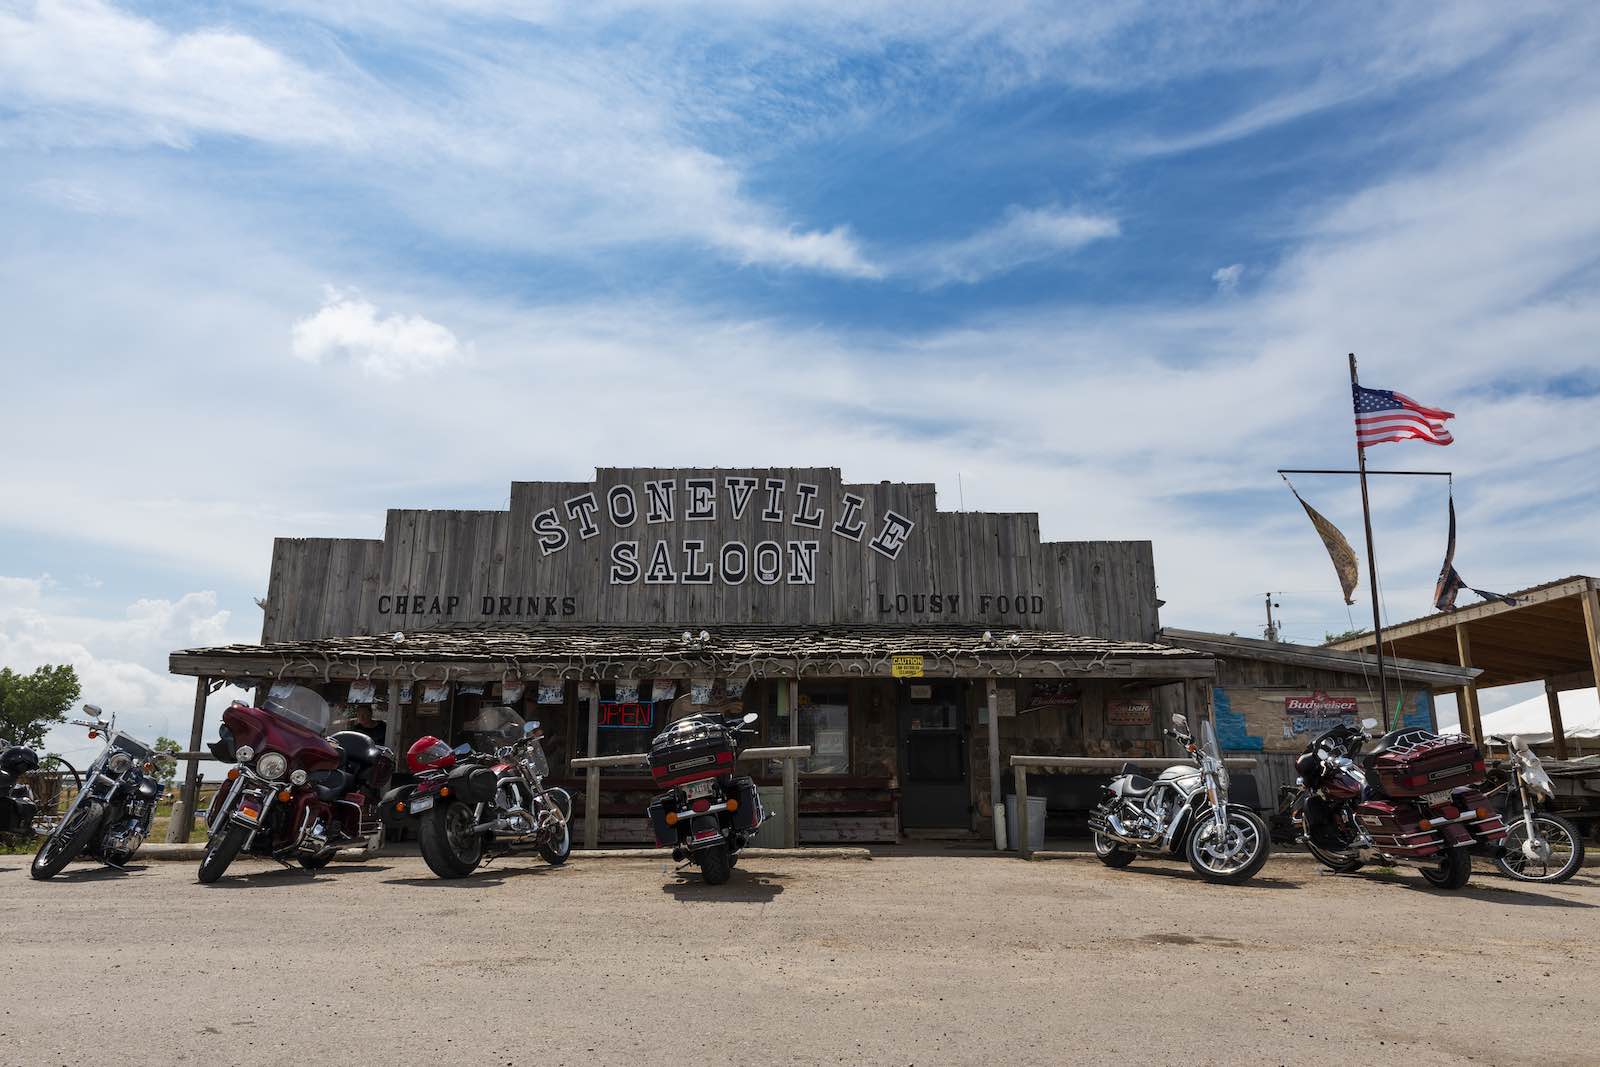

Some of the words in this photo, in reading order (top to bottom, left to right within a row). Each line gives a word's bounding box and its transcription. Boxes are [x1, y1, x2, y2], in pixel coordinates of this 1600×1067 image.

[532, 476, 914, 560] STONEVILLE
[610, 540, 819, 585] SALOON
[378, 595, 460, 615] CHEAP
[481, 596, 576, 616] DRINKS
[878, 594, 960, 614] LOUSY
[979, 595, 1043, 614] FOOD
[893, 657, 923, 665] CAUTION
[1288, 699, 1356, 710] Budweiser
